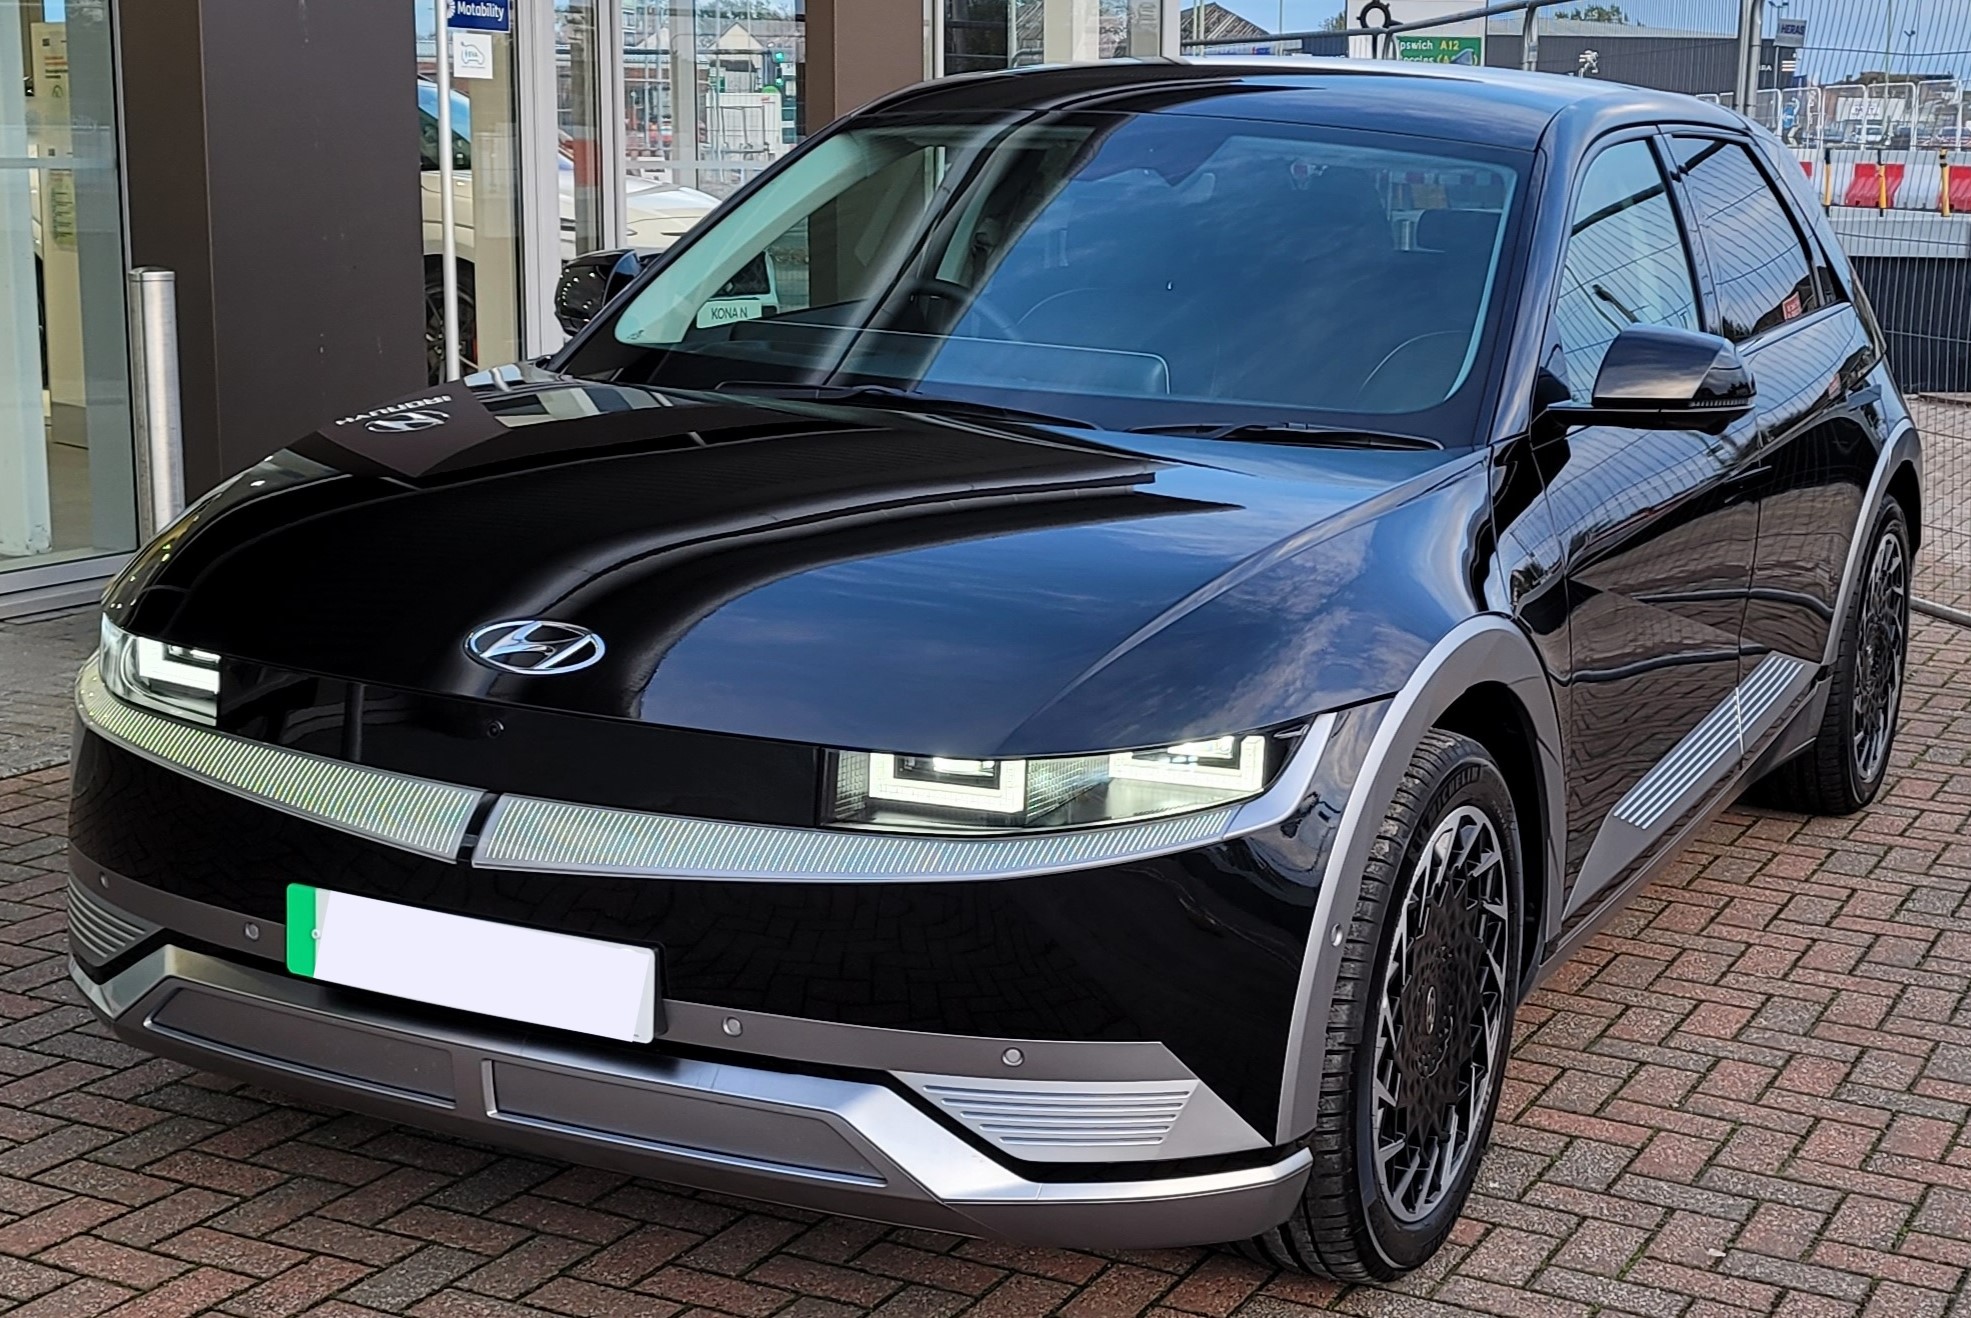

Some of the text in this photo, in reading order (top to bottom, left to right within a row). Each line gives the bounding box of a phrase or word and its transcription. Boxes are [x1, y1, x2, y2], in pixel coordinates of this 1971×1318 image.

[457, 1, 505, 22] Motability
[1781, 23, 1805, 35] HERAS
[1440, 40, 1460, 51] A12
[711, 306, 748, 320] KONA N
